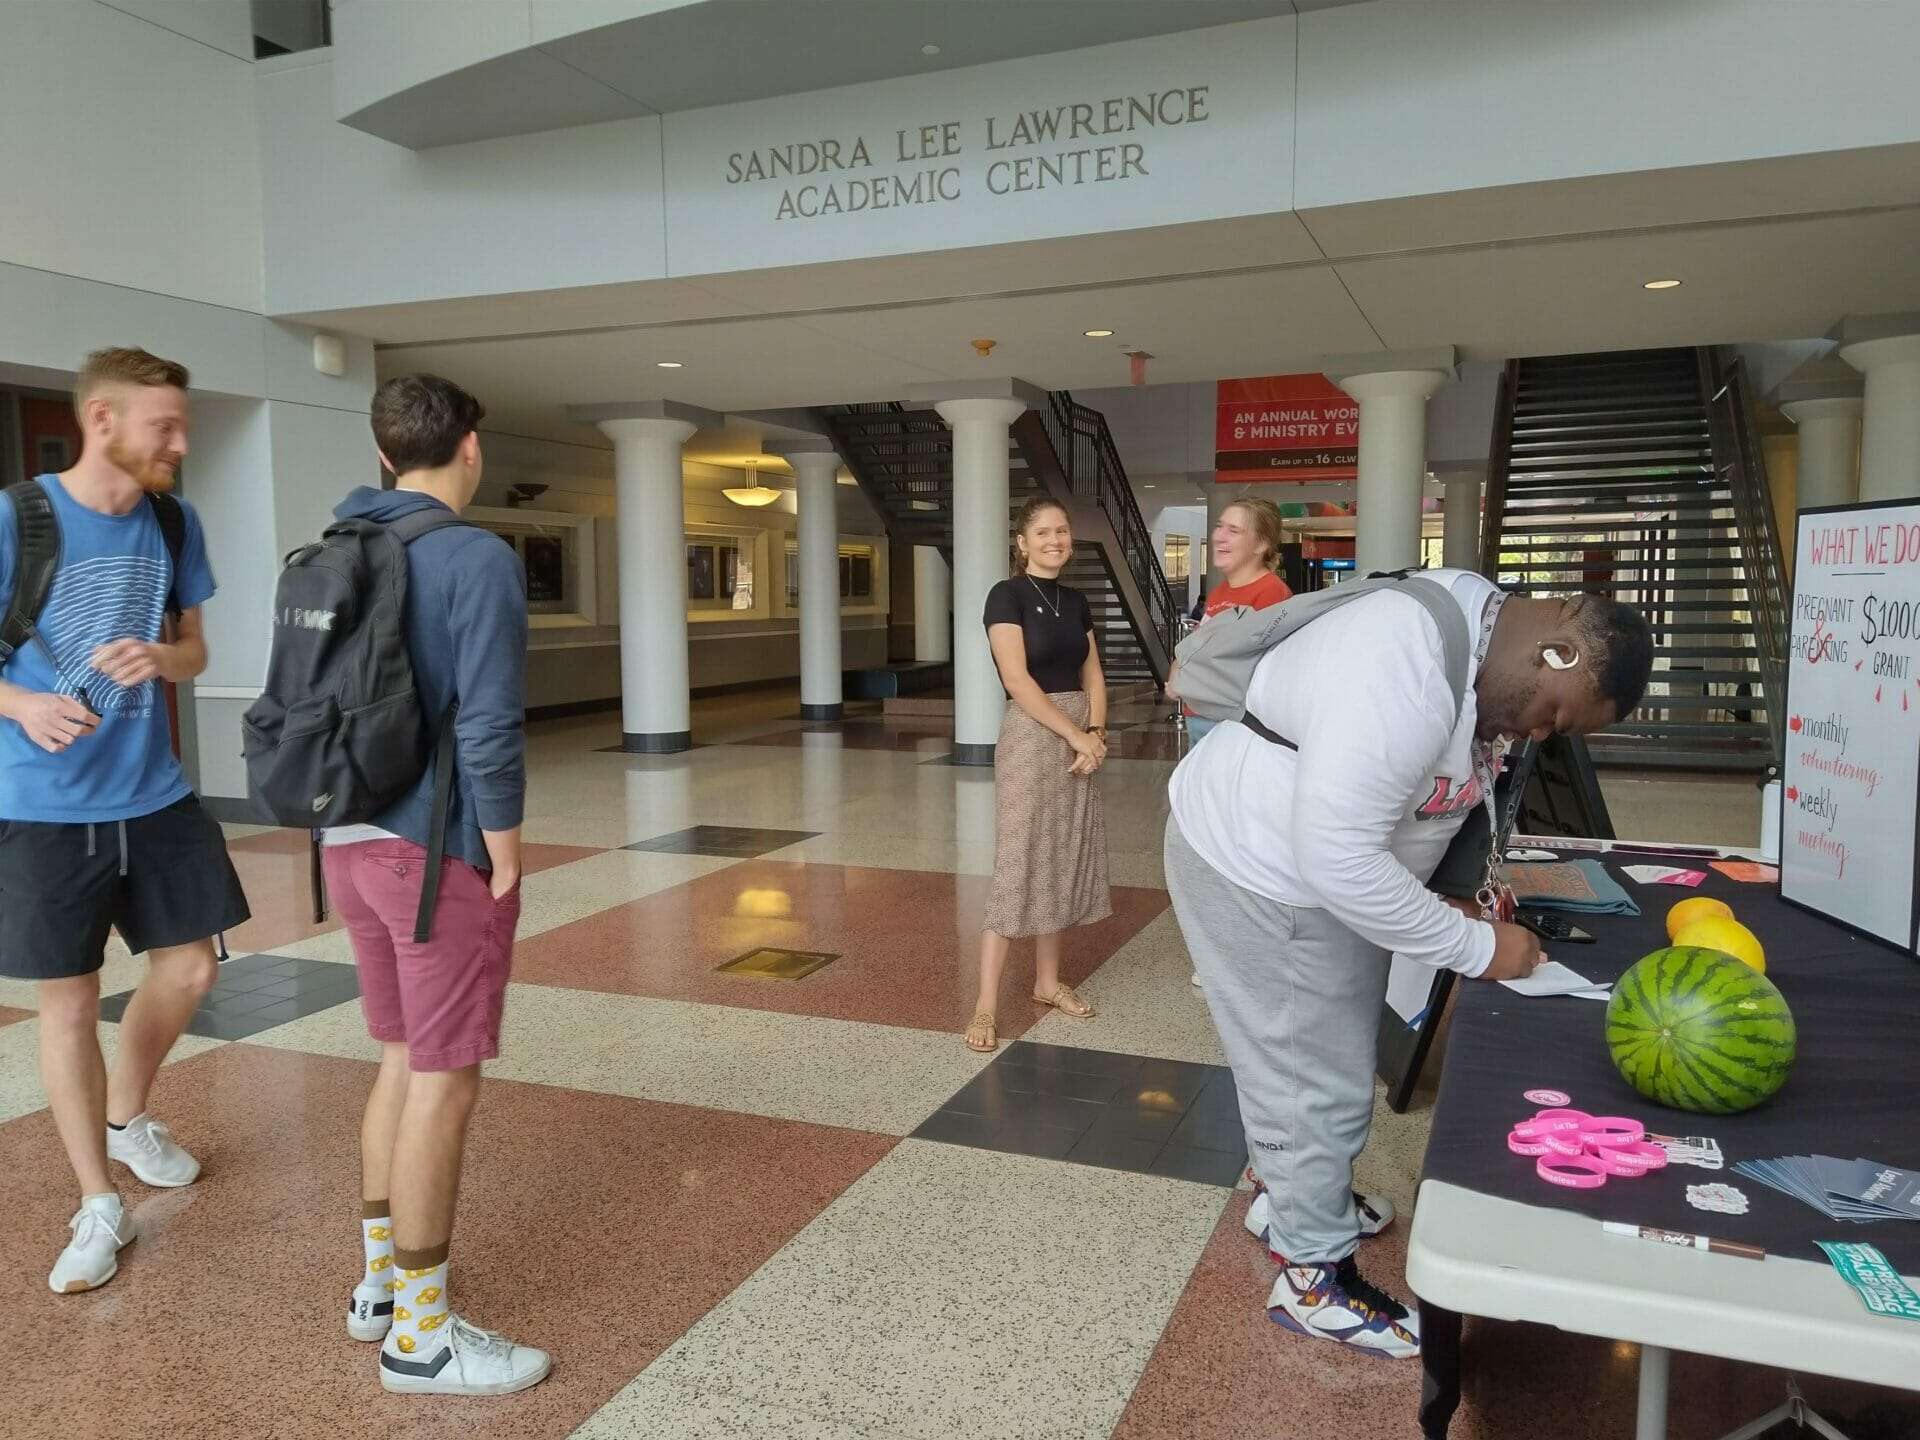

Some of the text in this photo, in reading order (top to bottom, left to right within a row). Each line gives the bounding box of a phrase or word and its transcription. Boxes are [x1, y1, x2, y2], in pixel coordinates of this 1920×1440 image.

[726, 86, 1209, 184] SANDRA LEE LAWRENCE
[774, 143, 1149, 221] ACADEMIC CENTER
[1234, 413, 1254, 423] AN
[1259, 410, 1318, 422] ANNUAL
[1234, 422, 1358, 439] & MINISTRY EV
[1316, 454, 1330, 464] 16
[1811, 524, 1920, 565] WHAT WE DO
[1796, 593, 1854, 622] PREGNANT
[1873, 651, 1911, 679] GRANT
[1801, 712, 1849, 755] monthly
[1799, 786, 1838, 832] weekly
